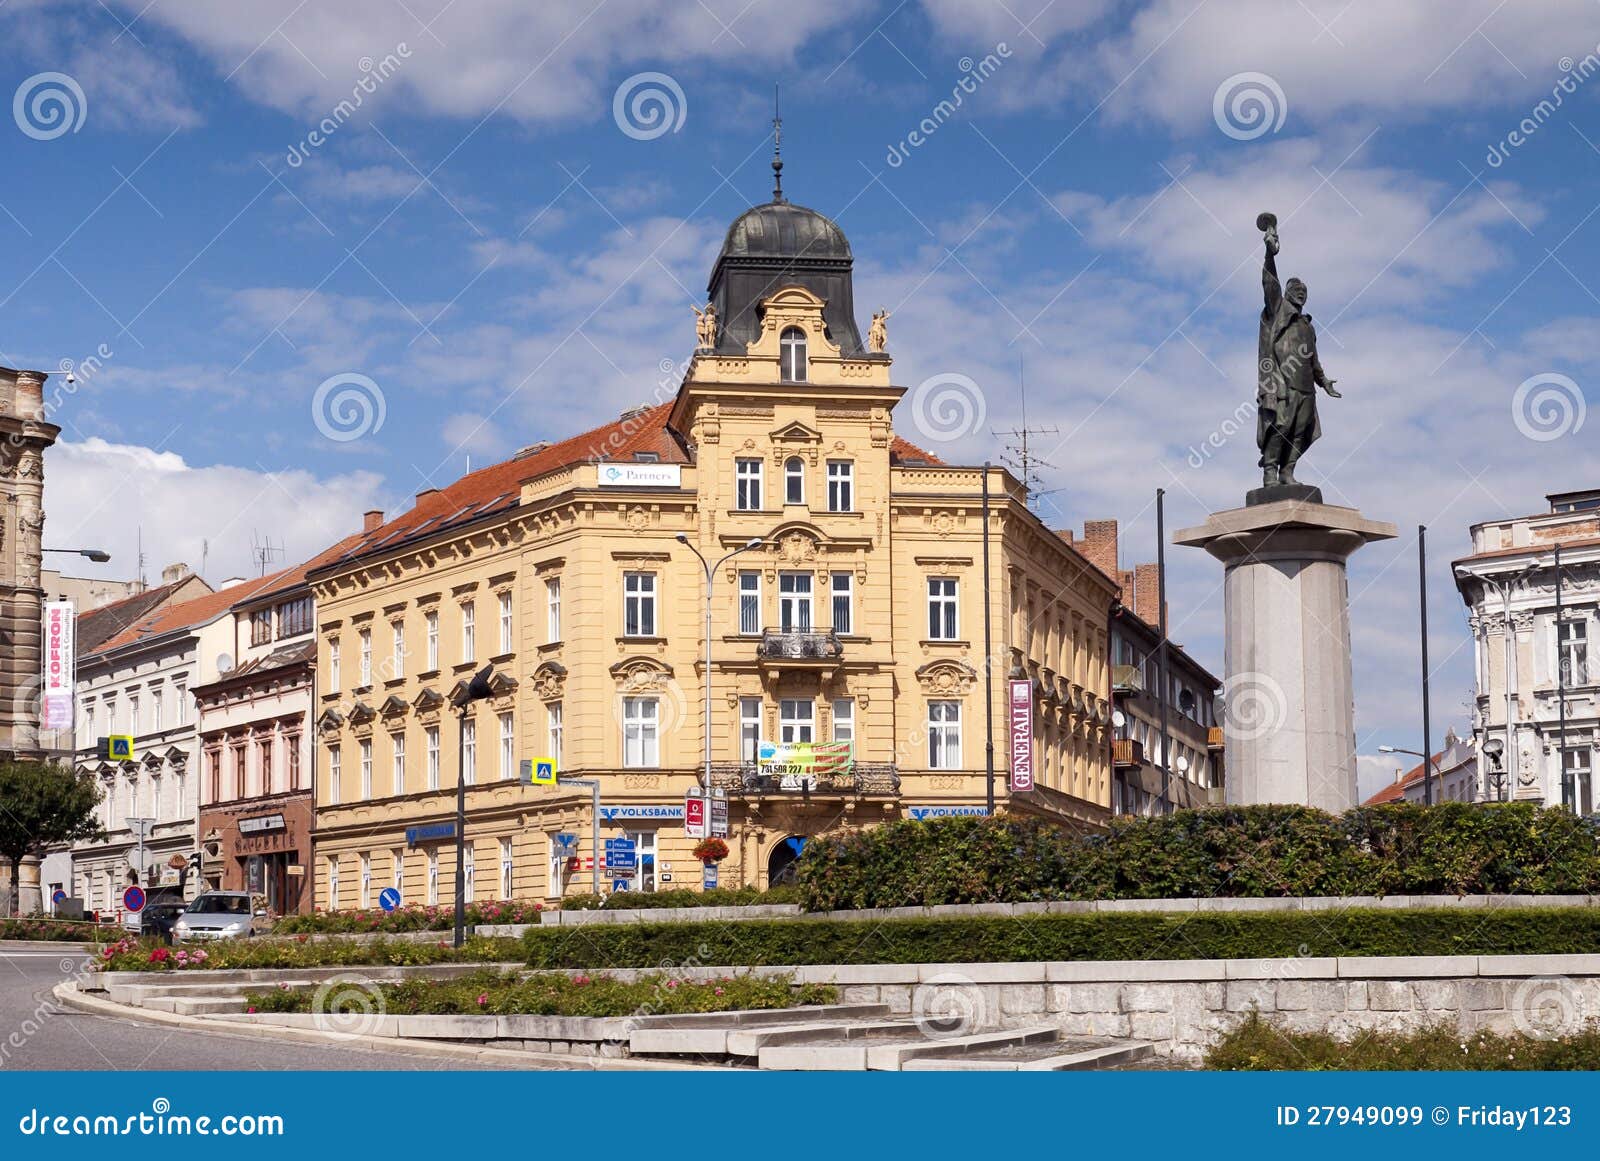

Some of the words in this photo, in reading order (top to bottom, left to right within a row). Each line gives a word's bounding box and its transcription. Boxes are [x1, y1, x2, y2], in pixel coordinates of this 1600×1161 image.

[626, 470, 672, 480] Partners
[63, 608, 71, 644] Consulting
[63, 652, 71, 688] Production
[1013, 707, 1030, 788] GENERALI
[621, 808, 684, 817] VOLKSBANK
